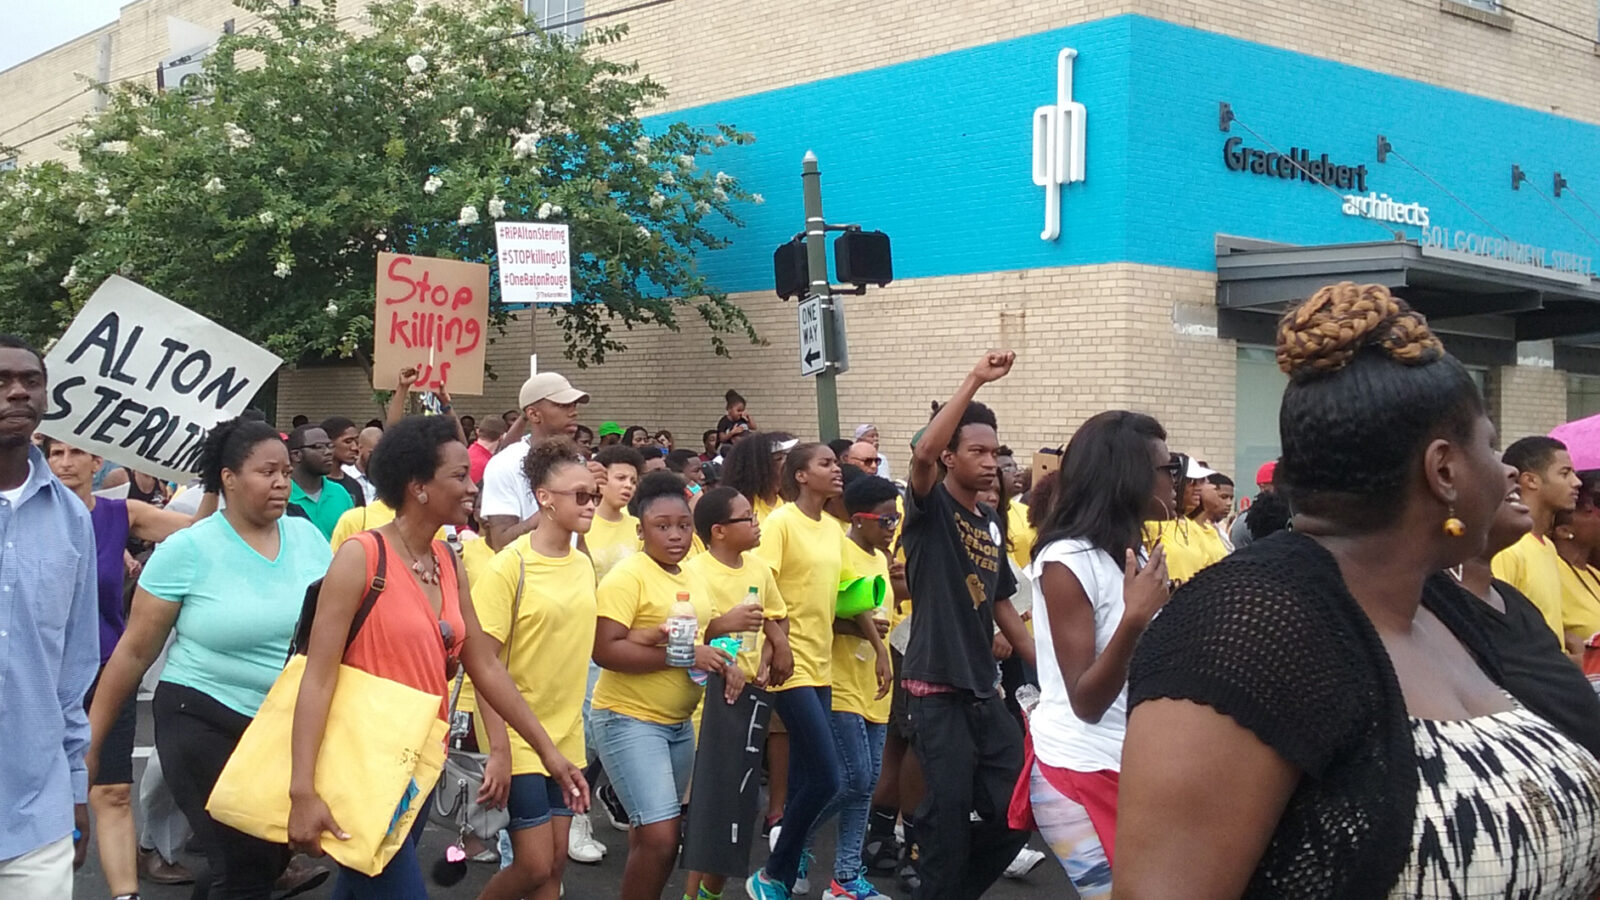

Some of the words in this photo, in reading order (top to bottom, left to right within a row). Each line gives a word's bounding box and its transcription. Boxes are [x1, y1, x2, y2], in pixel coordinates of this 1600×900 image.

[1224, 136, 1369, 192] GraceHebert
[1342, 191, 1430, 226] architects
[1422, 224, 1449, 250] 501
[502, 248, 567, 269] #STOPkillingUS
[385, 256, 473, 311] Stop
[504, 272, 568, 289] #OneBatonRouge
[802, 303, 817, 325] ONE
[389, 311, 480, 356] killing
[803, 324, 818, 345] WAY
[66, 311, 250, 410] ALTON
